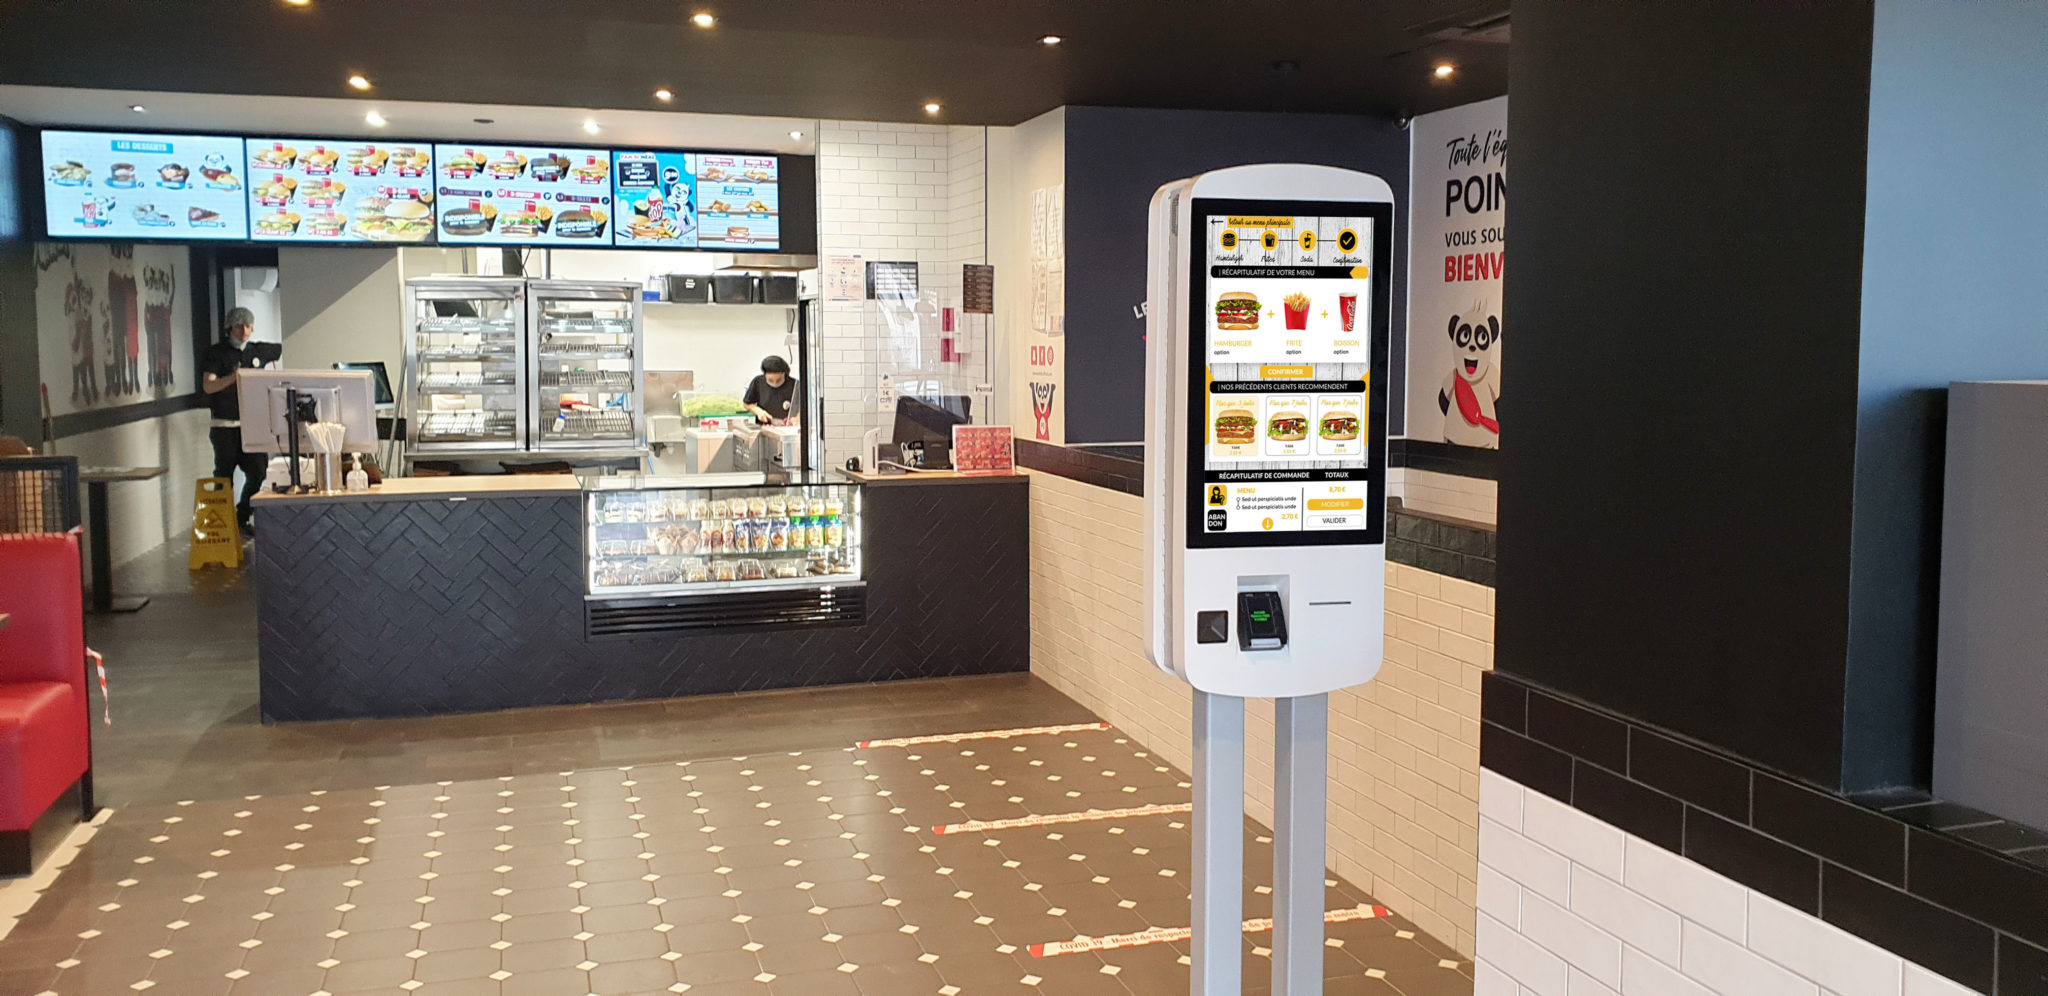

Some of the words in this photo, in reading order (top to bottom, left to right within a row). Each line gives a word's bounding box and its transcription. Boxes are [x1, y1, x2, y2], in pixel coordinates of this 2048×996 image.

[1446, 133, 1481, 170] Toute
[1445, 172, 1507, 217] POIN
[1444, 250, 1505, 283] BIENV
[1221, 267, 1266, 276] RÉCAPITULATIF
[1266, 268, 1276, 276] DE
[1276, 268, 1296, 276] VOTRE
[1296, 268, 1315, 277] MENU
[1267, 368, 1304, 376] CONFIRMER
[1220, 383, 1234, 391] NOS
[1234, 381, 1272, 391] PRÉCÉDENTS
[1297, 382, 1348, 390] RECOMMENDENT
[1218, 472, 1264, 480] RÉCAPITULATIF
[1273, 471, 1310, 479] COMMANDE
